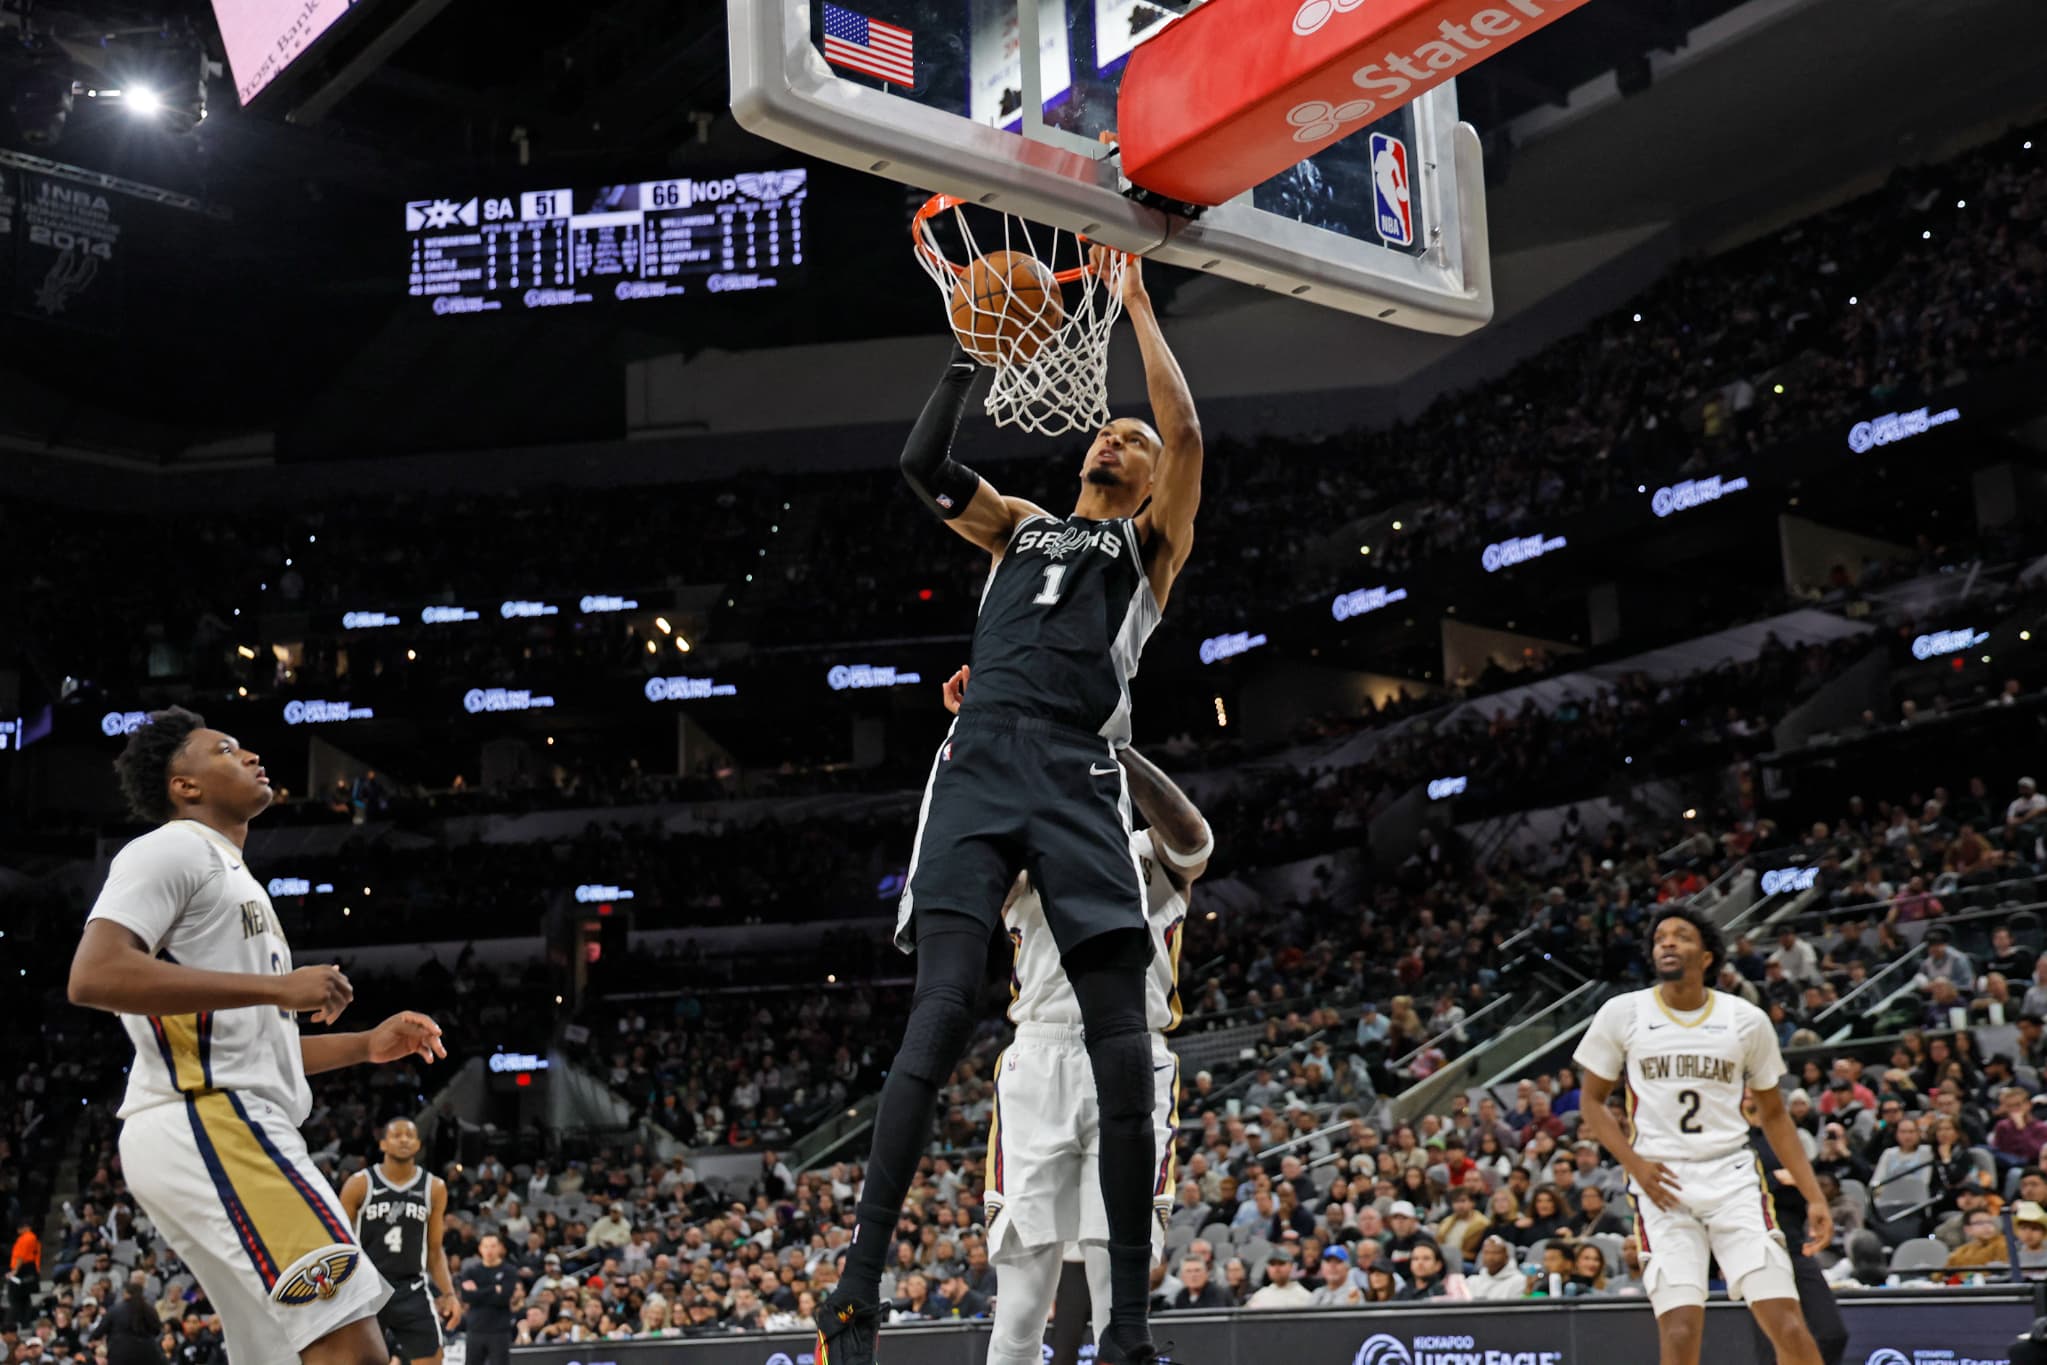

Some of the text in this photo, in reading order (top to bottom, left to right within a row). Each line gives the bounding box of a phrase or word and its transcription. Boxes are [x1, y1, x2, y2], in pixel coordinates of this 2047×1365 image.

[484, 179, 737, 220] SA 51 66 NOP
[1382, 214, 1399, 236] NBA
[30, 225, 112, 260] 2014
[1032, 564, 1066, 605] 1
[1639, 1055, 1671, 1081] NEW
[1678, 1090, 1703, 1134] 2
[384, 1225, 402, 1253] 4
[1413, 1336, 1474, 1350] KICKAPOO
